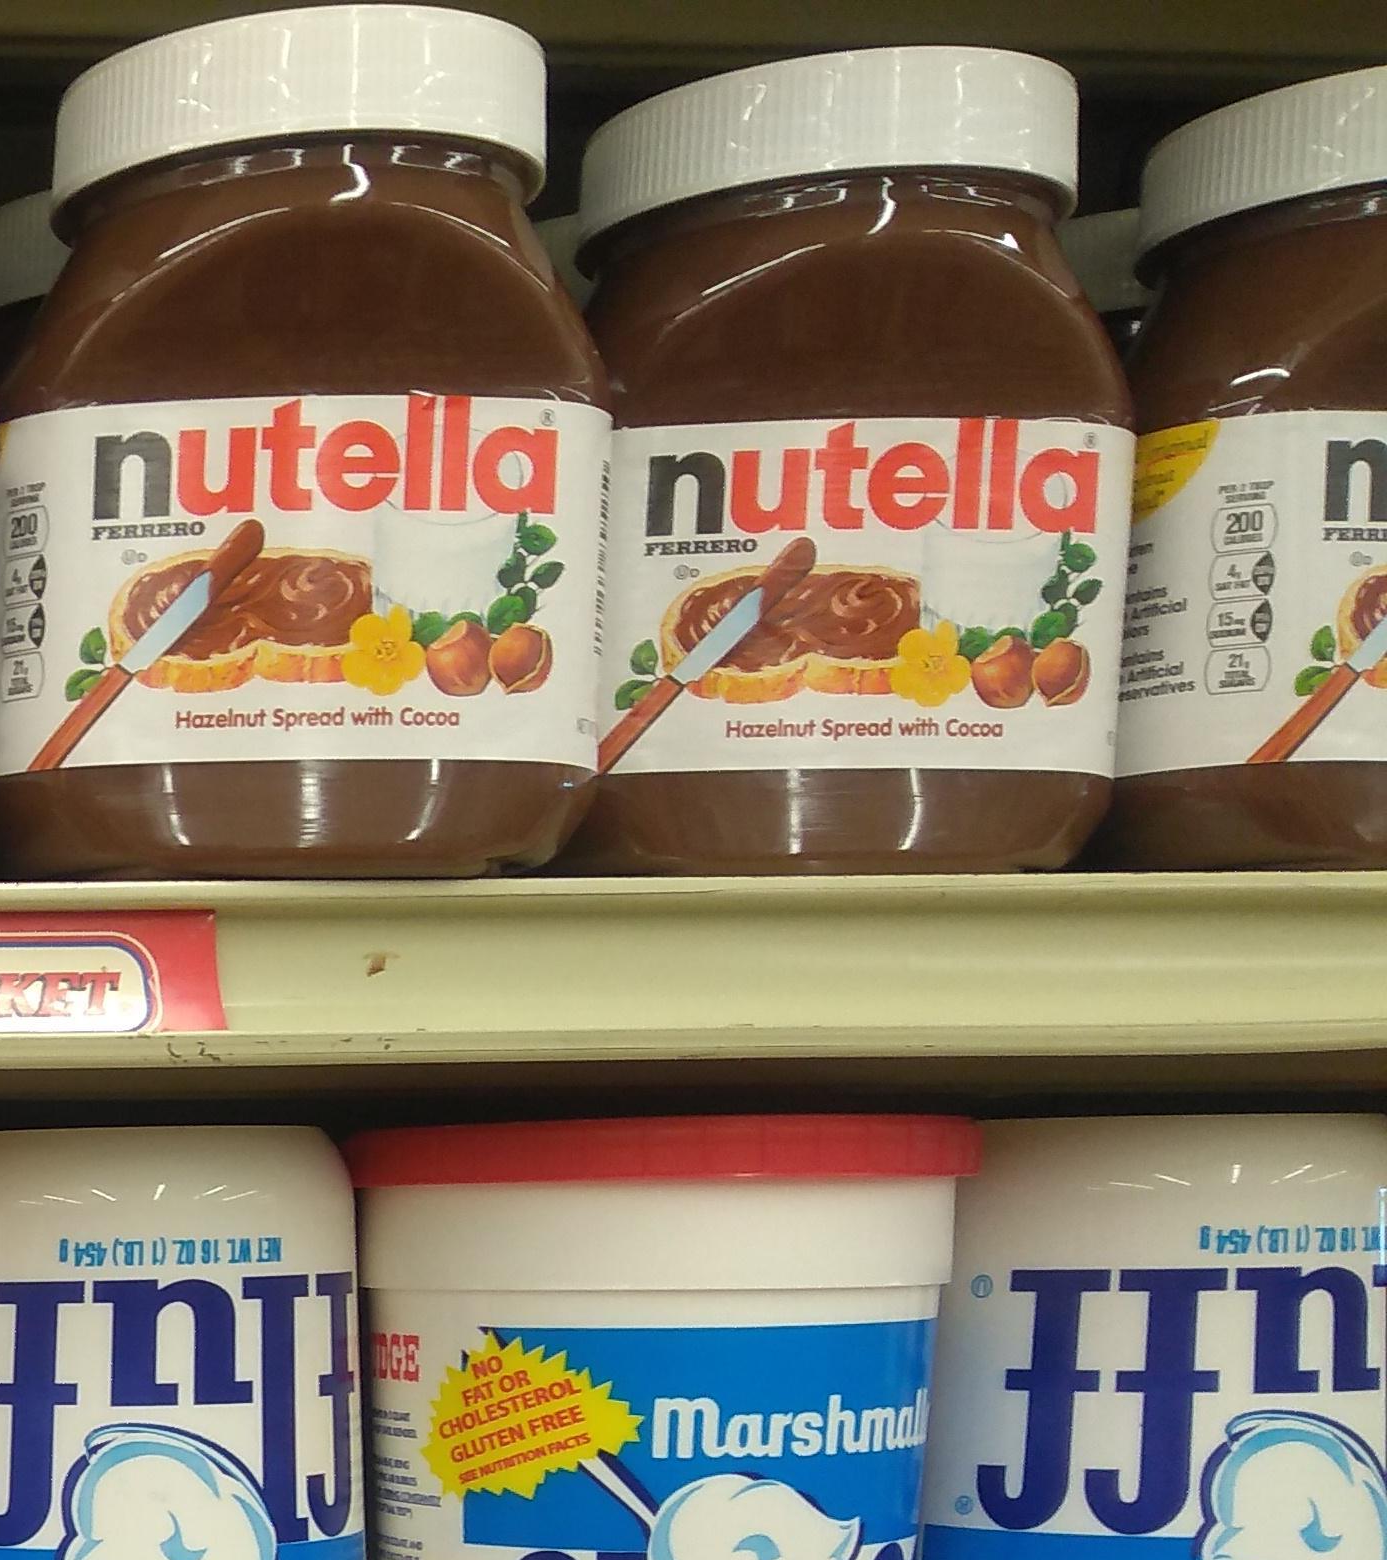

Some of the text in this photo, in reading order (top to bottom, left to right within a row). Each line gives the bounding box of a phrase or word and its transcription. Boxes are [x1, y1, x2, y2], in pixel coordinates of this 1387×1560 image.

[92, 395, 559, 520] nutella
[645, 418, 1101, 537] nutella
[92, 522, 205, 541] FERRERO
[1227, 510, 1263, 533] 200
[644, 538, 757, 556] FERRERO
[726, 718, 1003, 741] Hazelnut Spread with Cocoa
[471, 1356, 503, 1379] NO
[462, 1370, 531, 1407] FAT OR
[977, 1266, 1387, 1535] uff
[439, 1378, 581, 1439] CHOLESTEROL
[653, 1389, 928, 1458] Marshmall
[451, 1405, 585, 1462] GLUTEN FREE
[548, 1433, 591, 1455] FACTS
